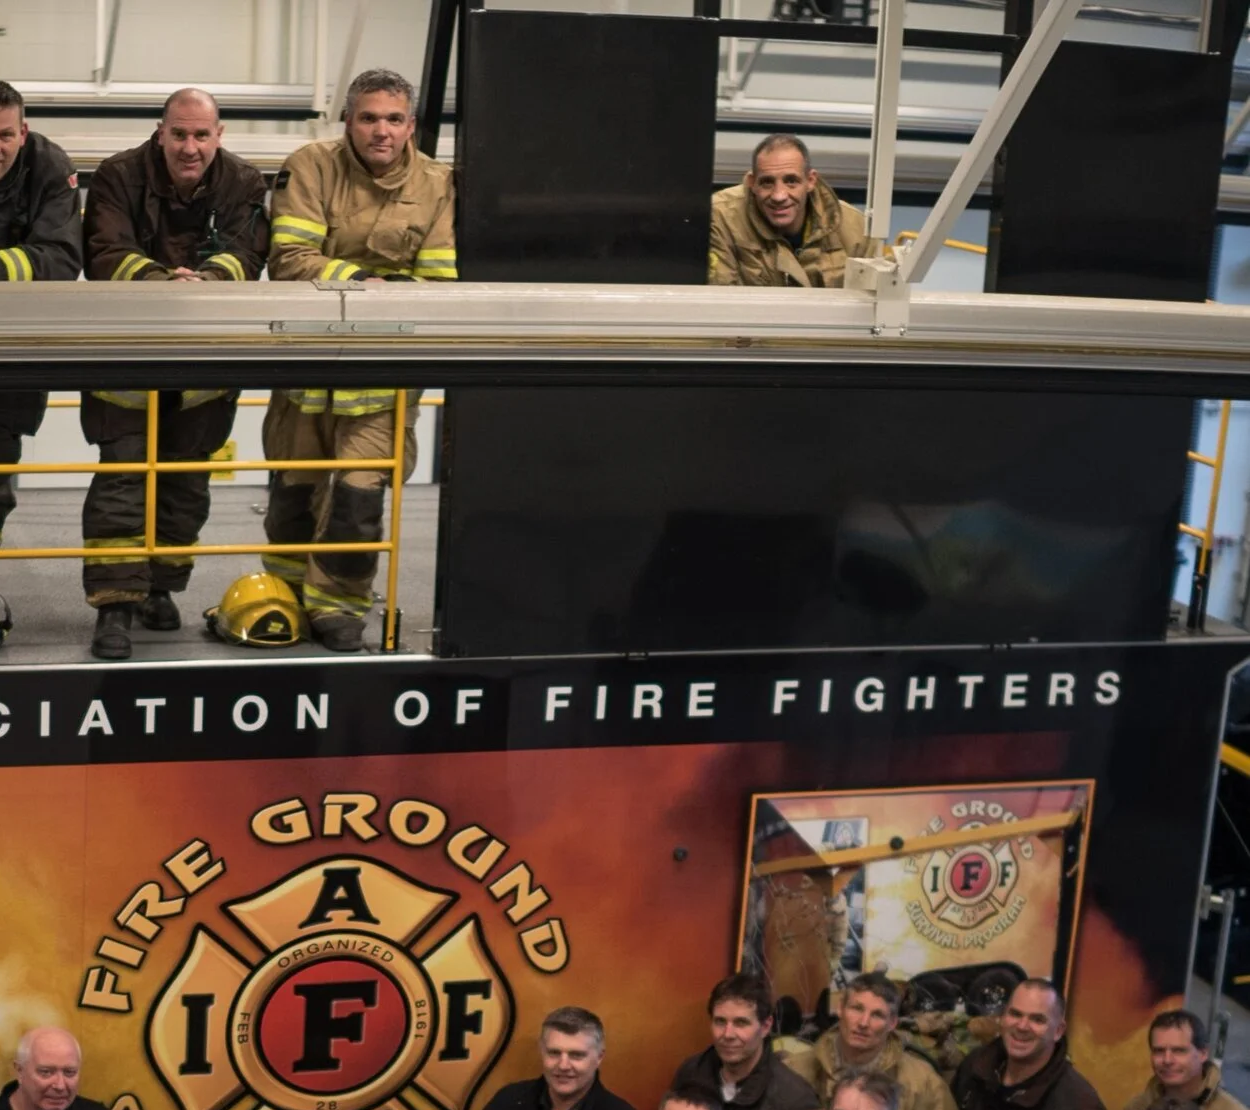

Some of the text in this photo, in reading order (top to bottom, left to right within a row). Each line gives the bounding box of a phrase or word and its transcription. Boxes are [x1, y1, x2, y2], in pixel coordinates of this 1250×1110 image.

[394, 689, 483, 727] OF
[545, 682, 716, 721] FIRE
[772, 671, 1122, 714] FIGHTERS
[904, 815, 946, 874] FE
[298, 867, 380, 928] A
[960, 861, 983, 891] F
[999, 861, 1013, 888] F
[79, 793, 569, 1013] FIRE GROUND
[906, 895, 1028, 950] SURVIVAL PROGRAM
[277, 939, 395, 969] ORGANIZED
[179, 994, 215, 1076] I
[237, 1012, 250, 1045] FEB
[292, 980, 379, 1073] F
[414, 998, 427, 1041] 1918
[439, 979, 492, 1062] F
